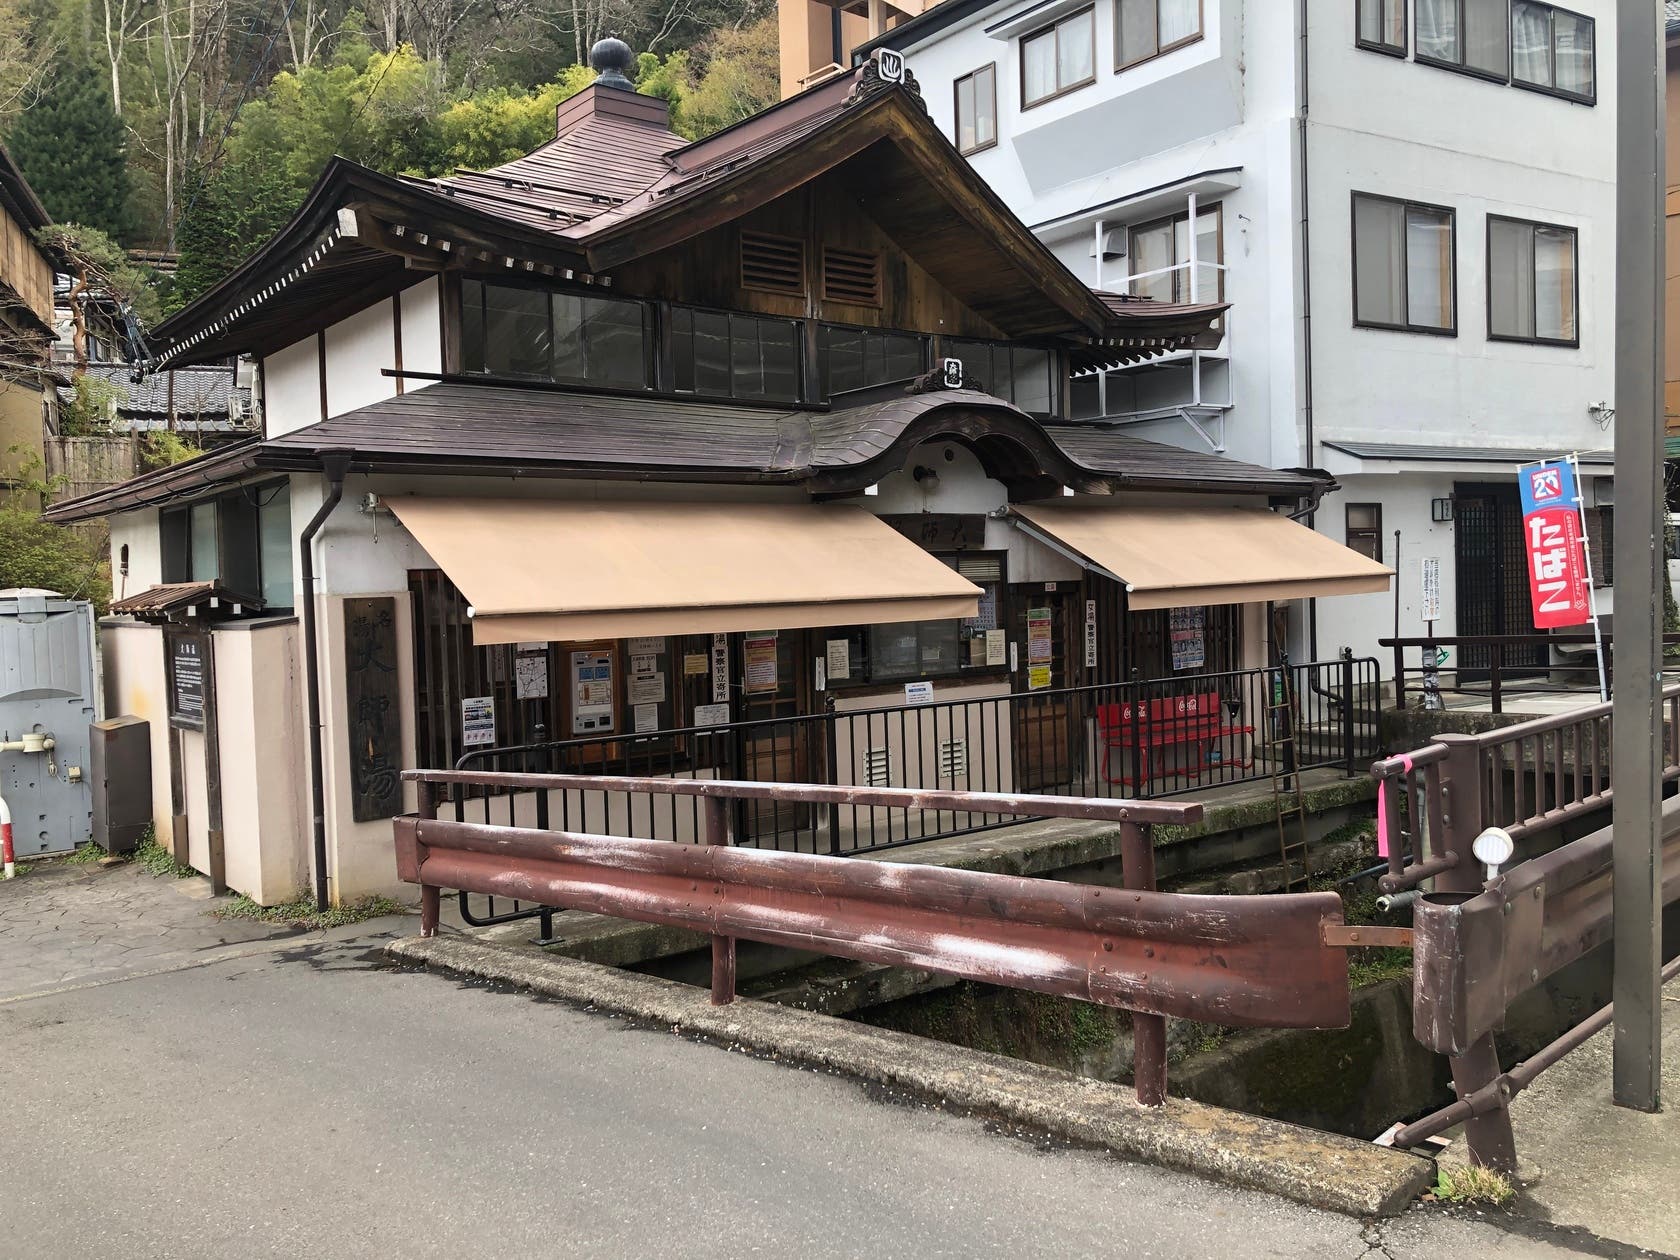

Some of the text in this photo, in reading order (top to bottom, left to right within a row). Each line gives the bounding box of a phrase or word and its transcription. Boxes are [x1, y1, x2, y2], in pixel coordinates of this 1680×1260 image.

[1534, 475, 1559, 499] 20
[1529, 516, 1570, 613] たばこ
[715, 649, 727, 700] 警察官立寄所
